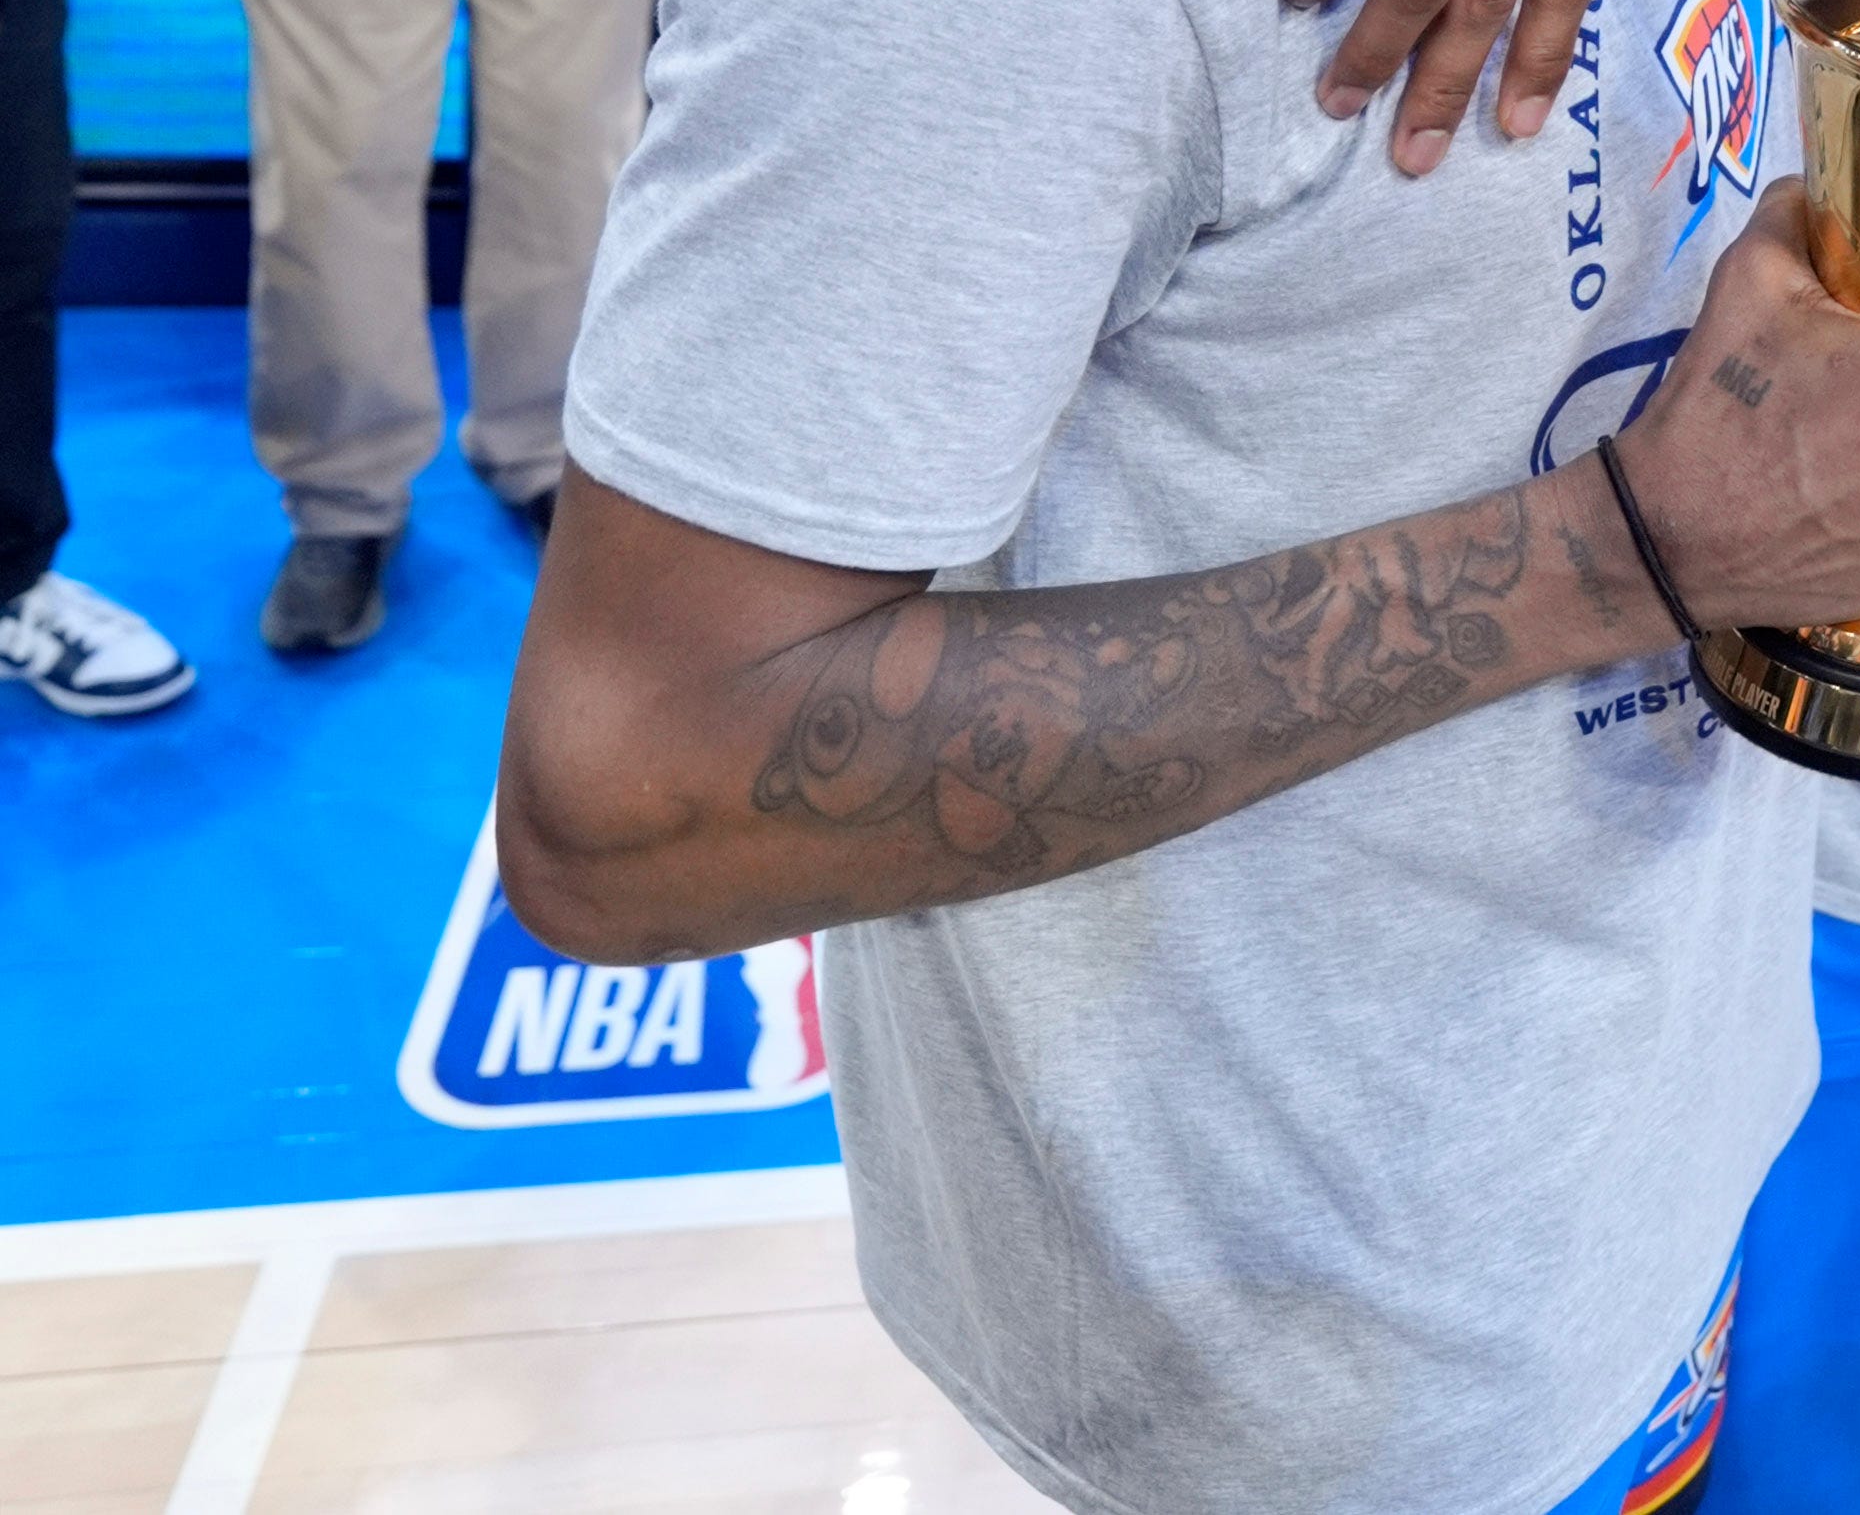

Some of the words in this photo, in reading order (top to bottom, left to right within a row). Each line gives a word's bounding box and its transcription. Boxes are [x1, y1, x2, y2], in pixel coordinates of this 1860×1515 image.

[1574, 675, 1694, 736] WEST
[1730, 671, 1781, 721] PLAYER
[476, 960, 708, 1078] NBA
